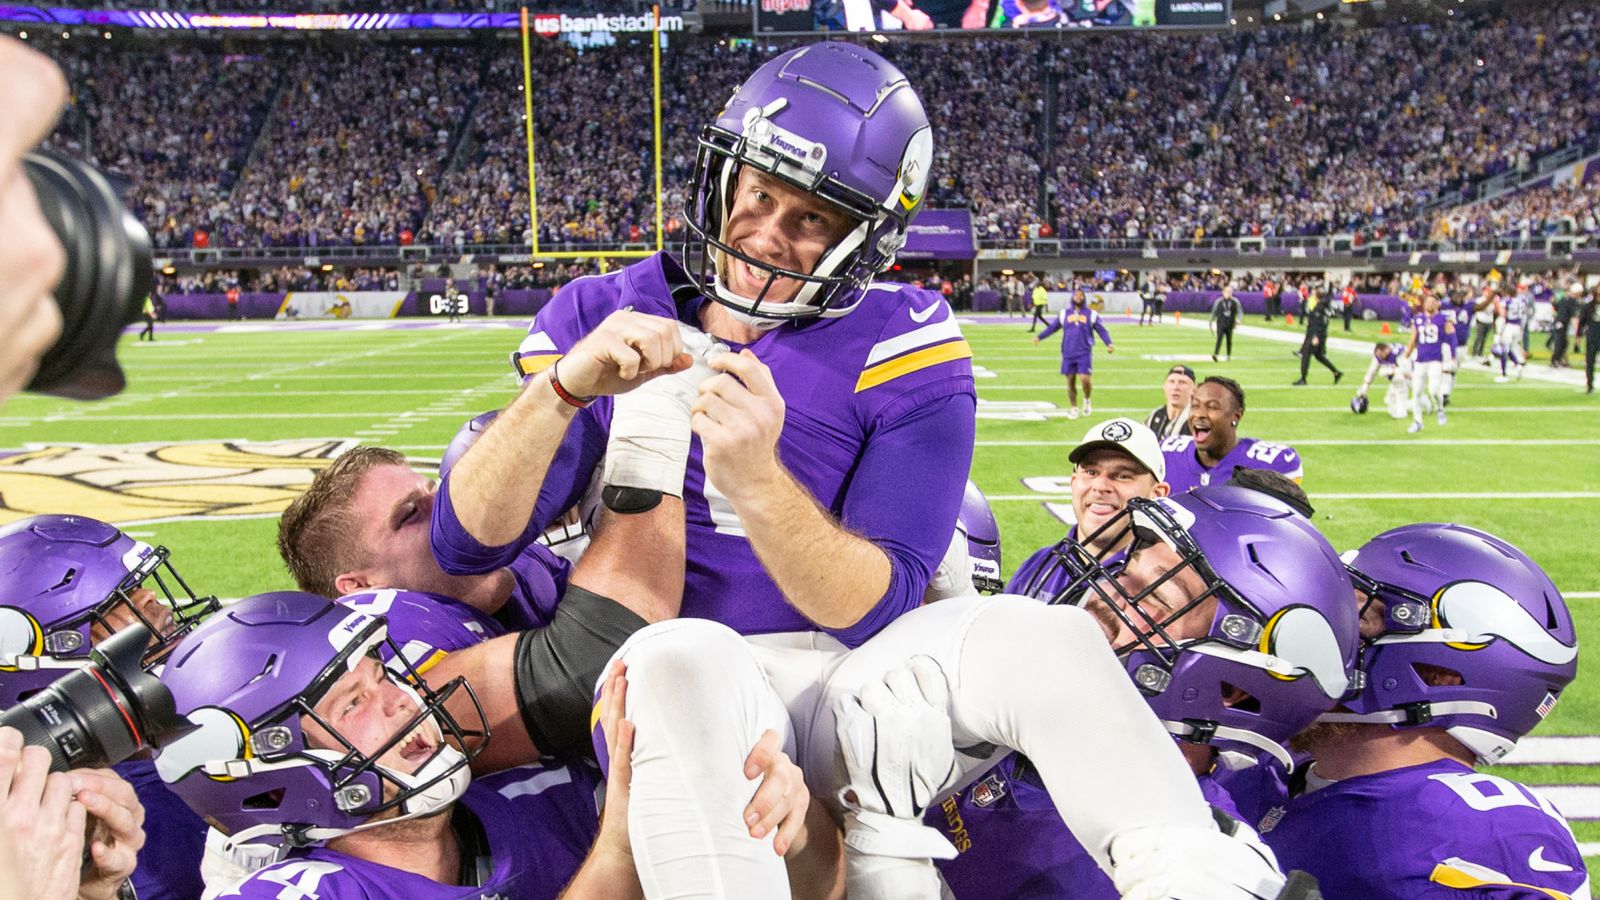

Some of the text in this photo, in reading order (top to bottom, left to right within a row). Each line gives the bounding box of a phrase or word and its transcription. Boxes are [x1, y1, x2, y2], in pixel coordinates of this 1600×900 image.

[430, 294, 469, 314] 0:3
[1417, 324, 1439, 344] 19
[941, 792, 972, 853] IKINGS
